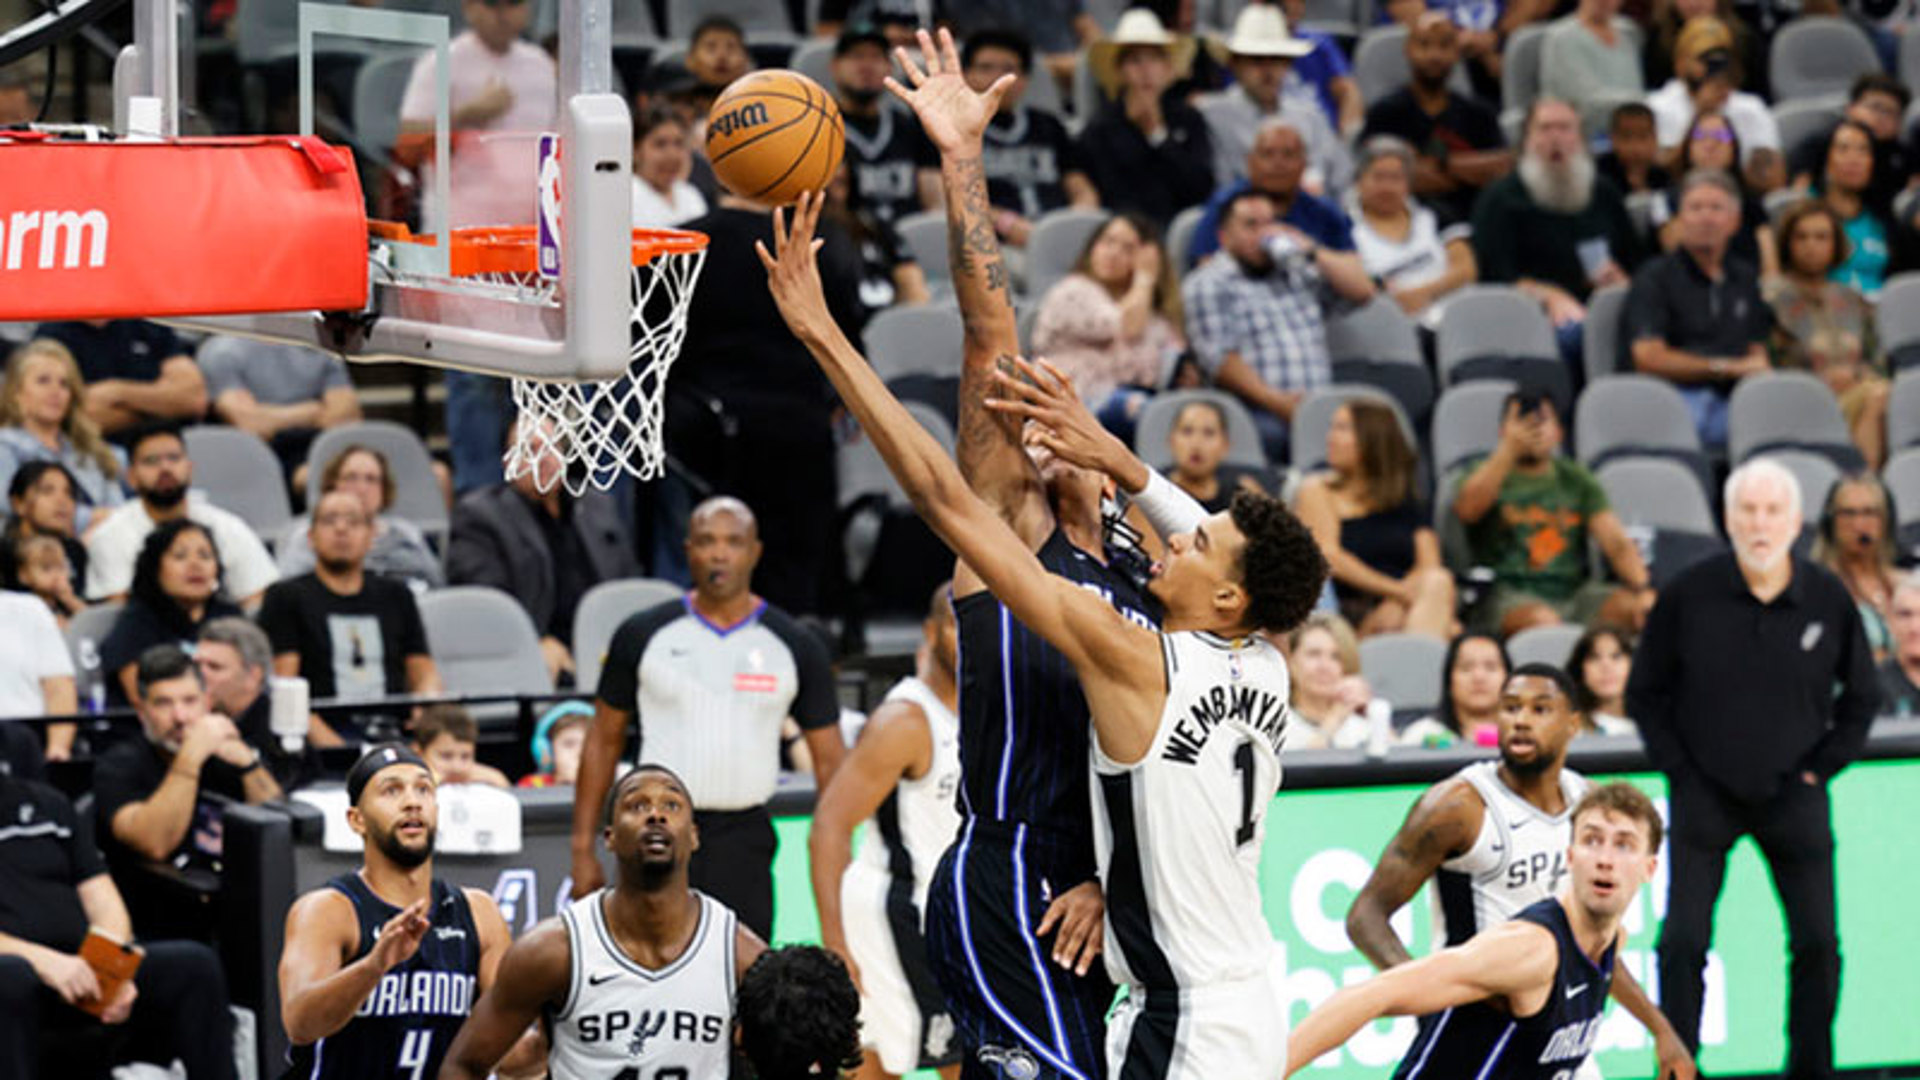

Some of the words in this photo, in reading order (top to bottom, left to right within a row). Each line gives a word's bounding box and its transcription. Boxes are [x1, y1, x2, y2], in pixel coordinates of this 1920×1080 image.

[0, 209, 109, 270] rm
[1233, 741, 1256, 847] 1
[398, 1029, 433, 1080] 4
[577, 1009, 723, 1057] SPURS
